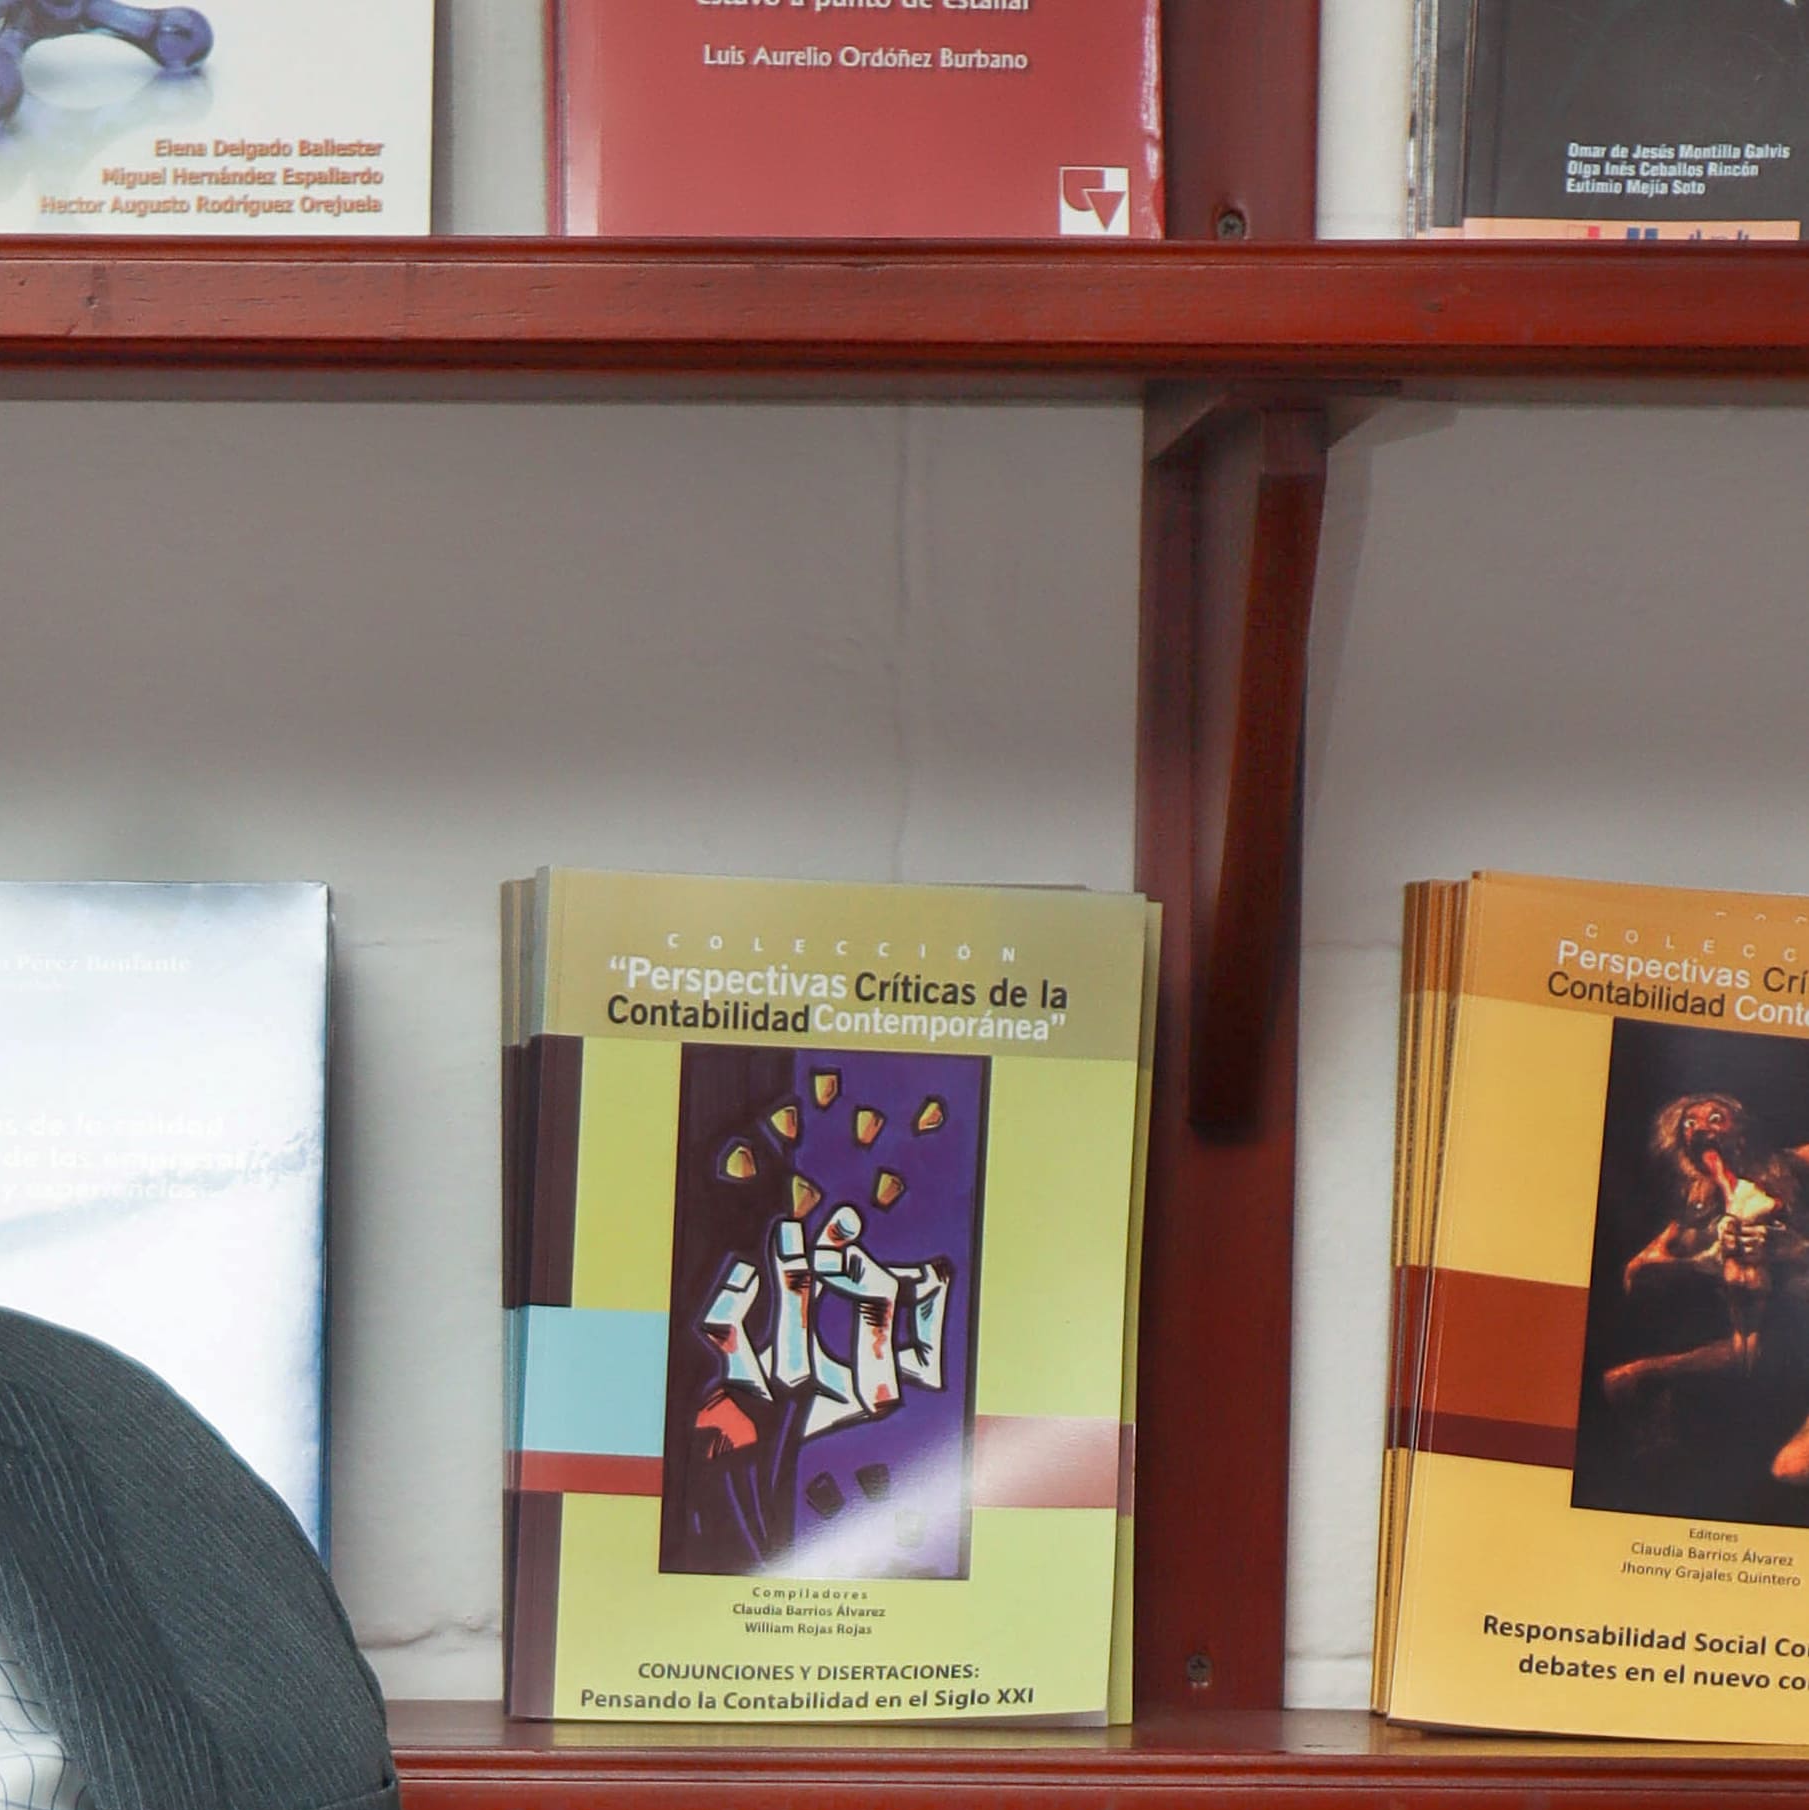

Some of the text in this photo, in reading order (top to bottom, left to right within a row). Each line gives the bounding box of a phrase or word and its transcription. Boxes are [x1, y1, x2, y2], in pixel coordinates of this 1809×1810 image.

[703, 44, 1028, 69] Luis Aurelio Ordóñez Burbano
[154, 139, 384, 161] Elena Delgado Ballester
[1567, 142, 1791, 159] Omar de Jesús Montilla Galvis
[101, 166, 383, 189] Miguel Hernández Espallardo
[1567, 160, 1759, 178] Olga Inés Ceballos Rincón
[1566, 178, 1706, 197] Eutimio Mejía Soto
[40, 194, 382, 217] Hector Augusto Rodríguez Orejuela
[1557, 939, 1751, 989] Perspectivas
[855, 972, 977, 1006] Críticas
[989, 977, 1028, 1008] de
[1040, 979, 1068, 1009] la
[1548, 971, 1726, 1017] Contabilidad
[608, 994, 810, 1032] Contabilidad
[1689, 1528, 1739, 1543] Editores
[1631, 1542, 1794, 1566] Claudia Barrios Álvarez
[1621, 1562, 1801, 1587] Jhonny Grajales Quintero
[752, 1586, 868, 1600] Compiladores
[732, 1603, 886, 1617] Claudia Barrios Álvarez
[745, 1621, 873, 1637] William Rojas Rojas
[1483, 1615, 1809, 1658] Responsabilidad Social Co
[638, 1663, 980, 1681] CONJUNCIONES Y DISERTACIONES:
[1519, 1654, 1809, 1691] debates en el nuevo co
[580, 1687, 1034, 1710] Pensando la Contabilidad en el Siglo XXI
